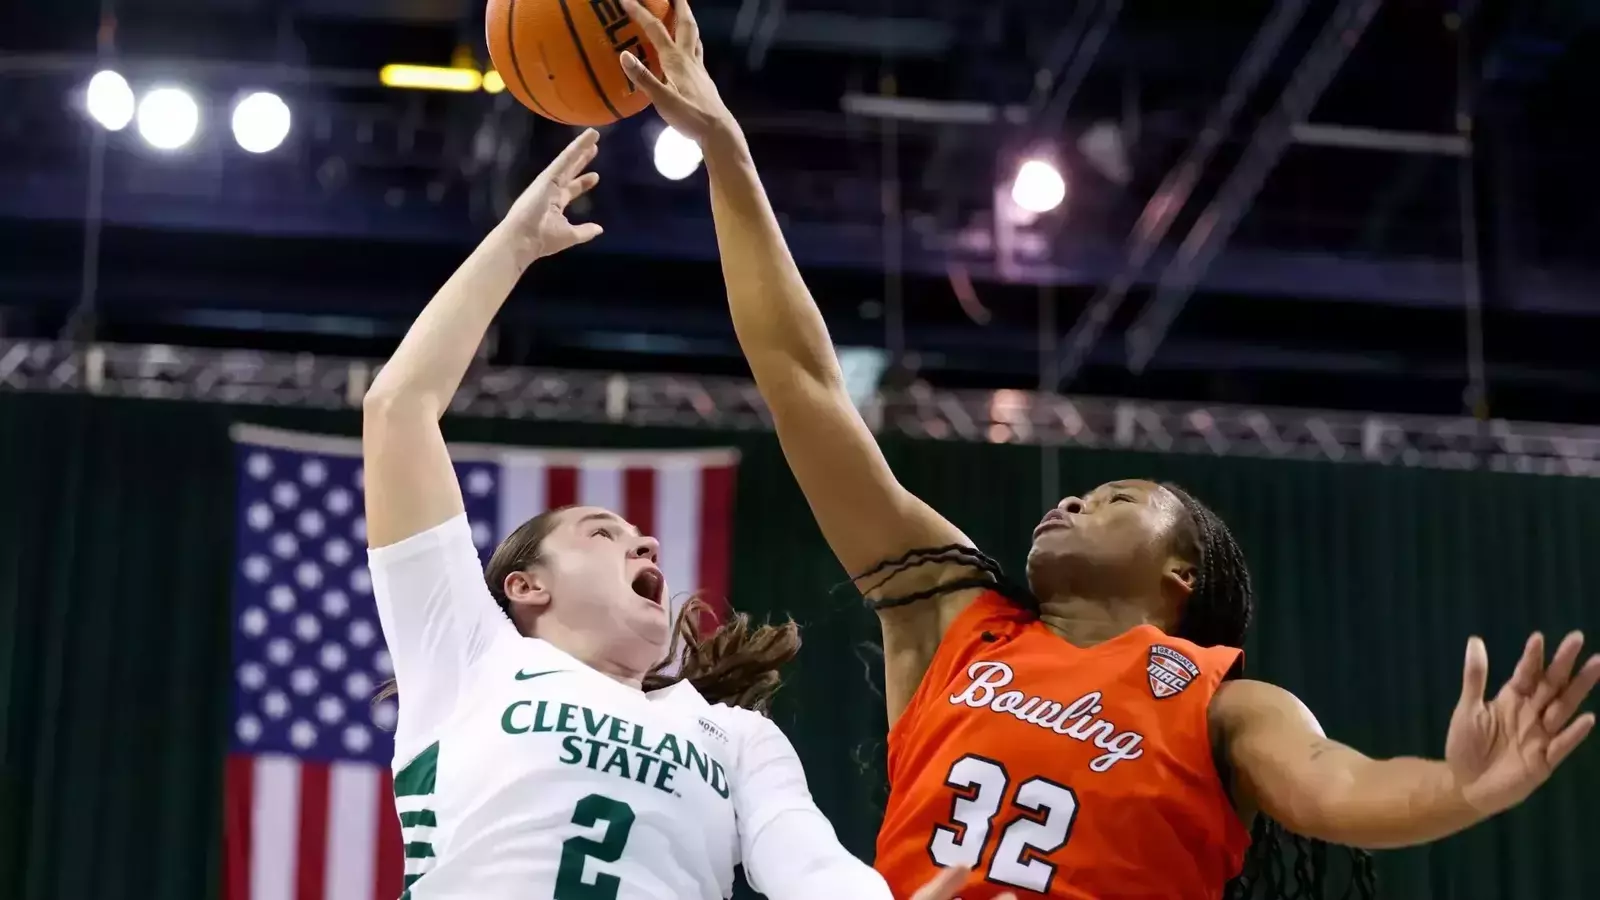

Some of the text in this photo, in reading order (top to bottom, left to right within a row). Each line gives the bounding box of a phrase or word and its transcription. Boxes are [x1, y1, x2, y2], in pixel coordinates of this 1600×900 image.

[1147, 663, 1188, 691] MAC
[1158, 646, 1194, 670] GRADUATE
[501, 700, 730, 799] CLEVELAND
[559, 735, 677, 795] STATE
[949, 660, 1144, 773] Bowling
[554, 793, 636, 900] 2
[927, 752, 1080, 894] 32
